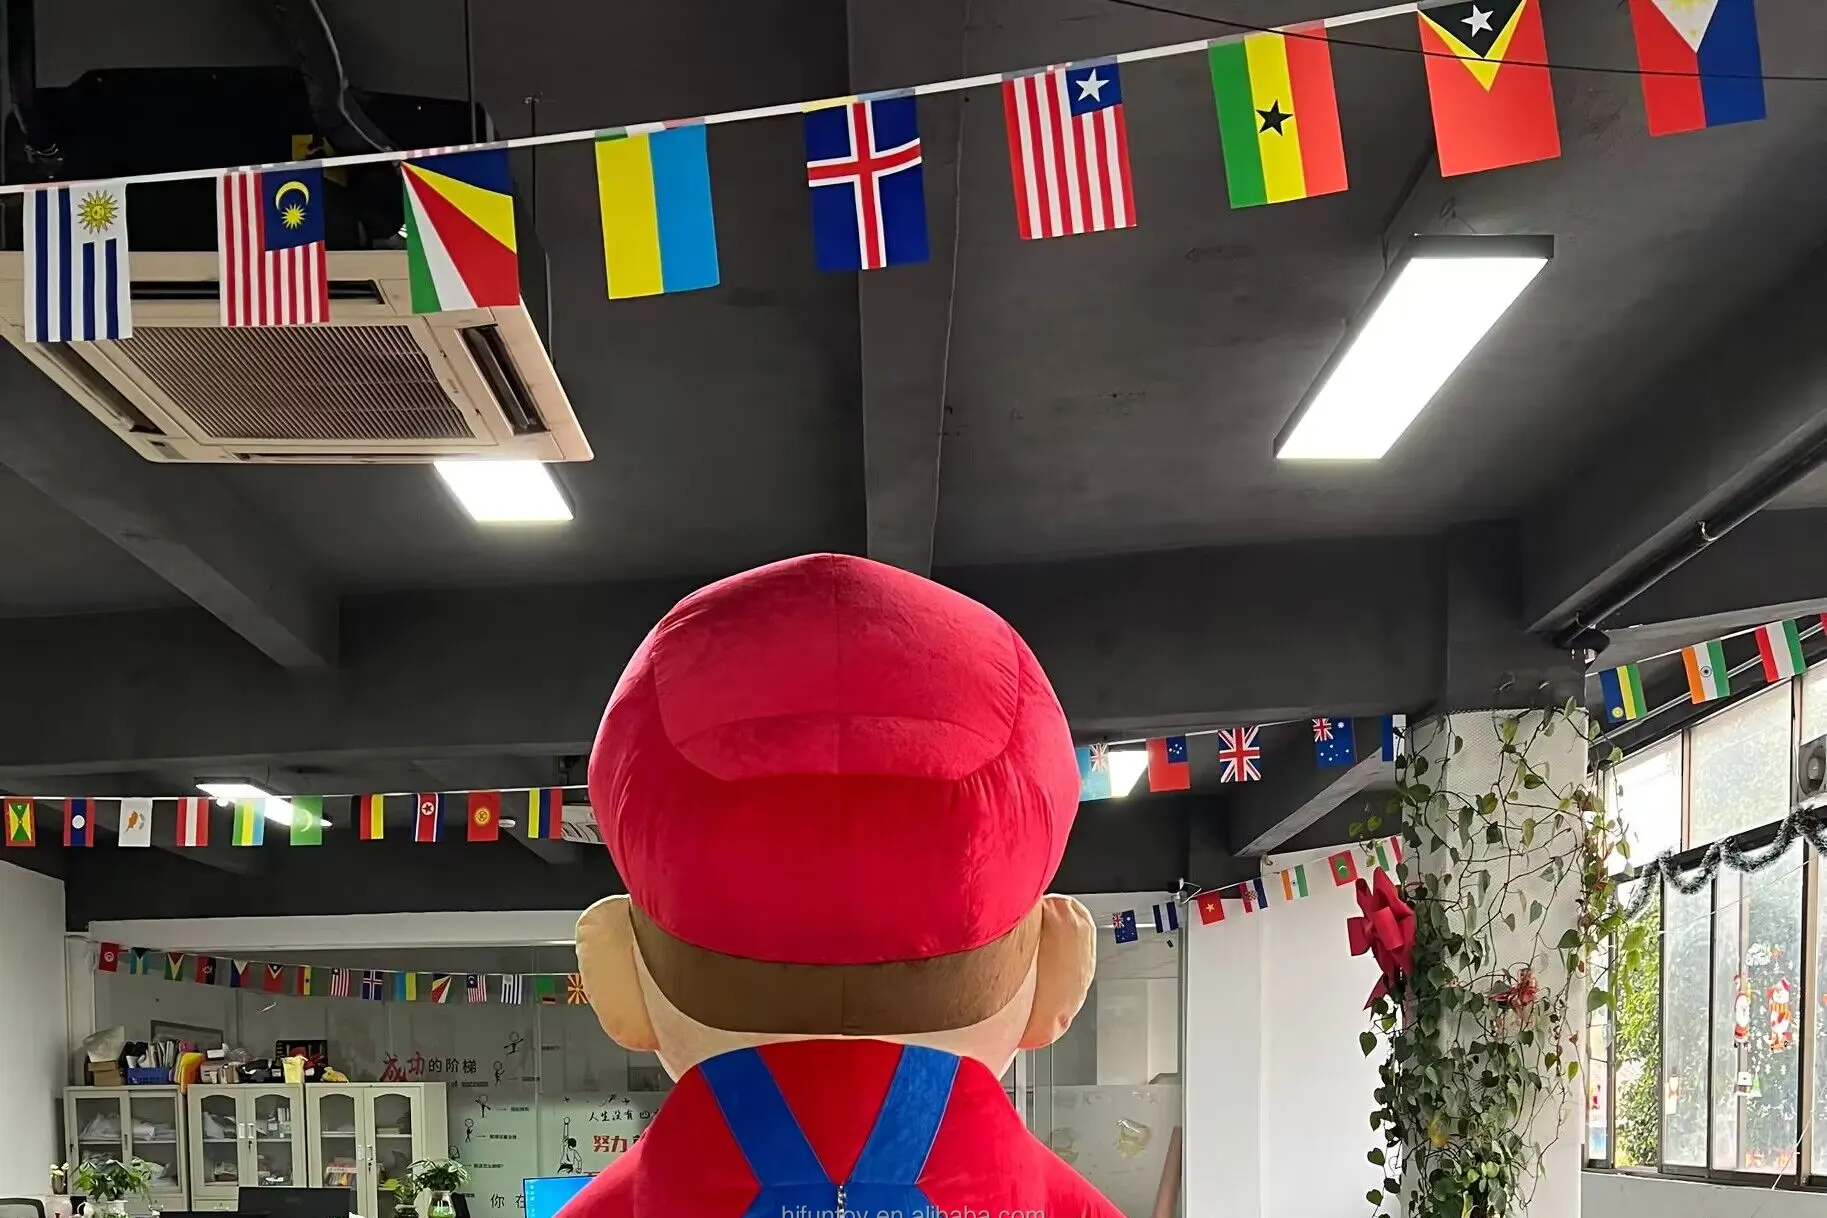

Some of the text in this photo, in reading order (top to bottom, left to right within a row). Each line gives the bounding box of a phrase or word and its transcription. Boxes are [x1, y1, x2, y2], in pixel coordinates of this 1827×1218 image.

[379, 1051, 477, 1081] 成功的阶梯
[593, 1135, 641, 1153] 努力
